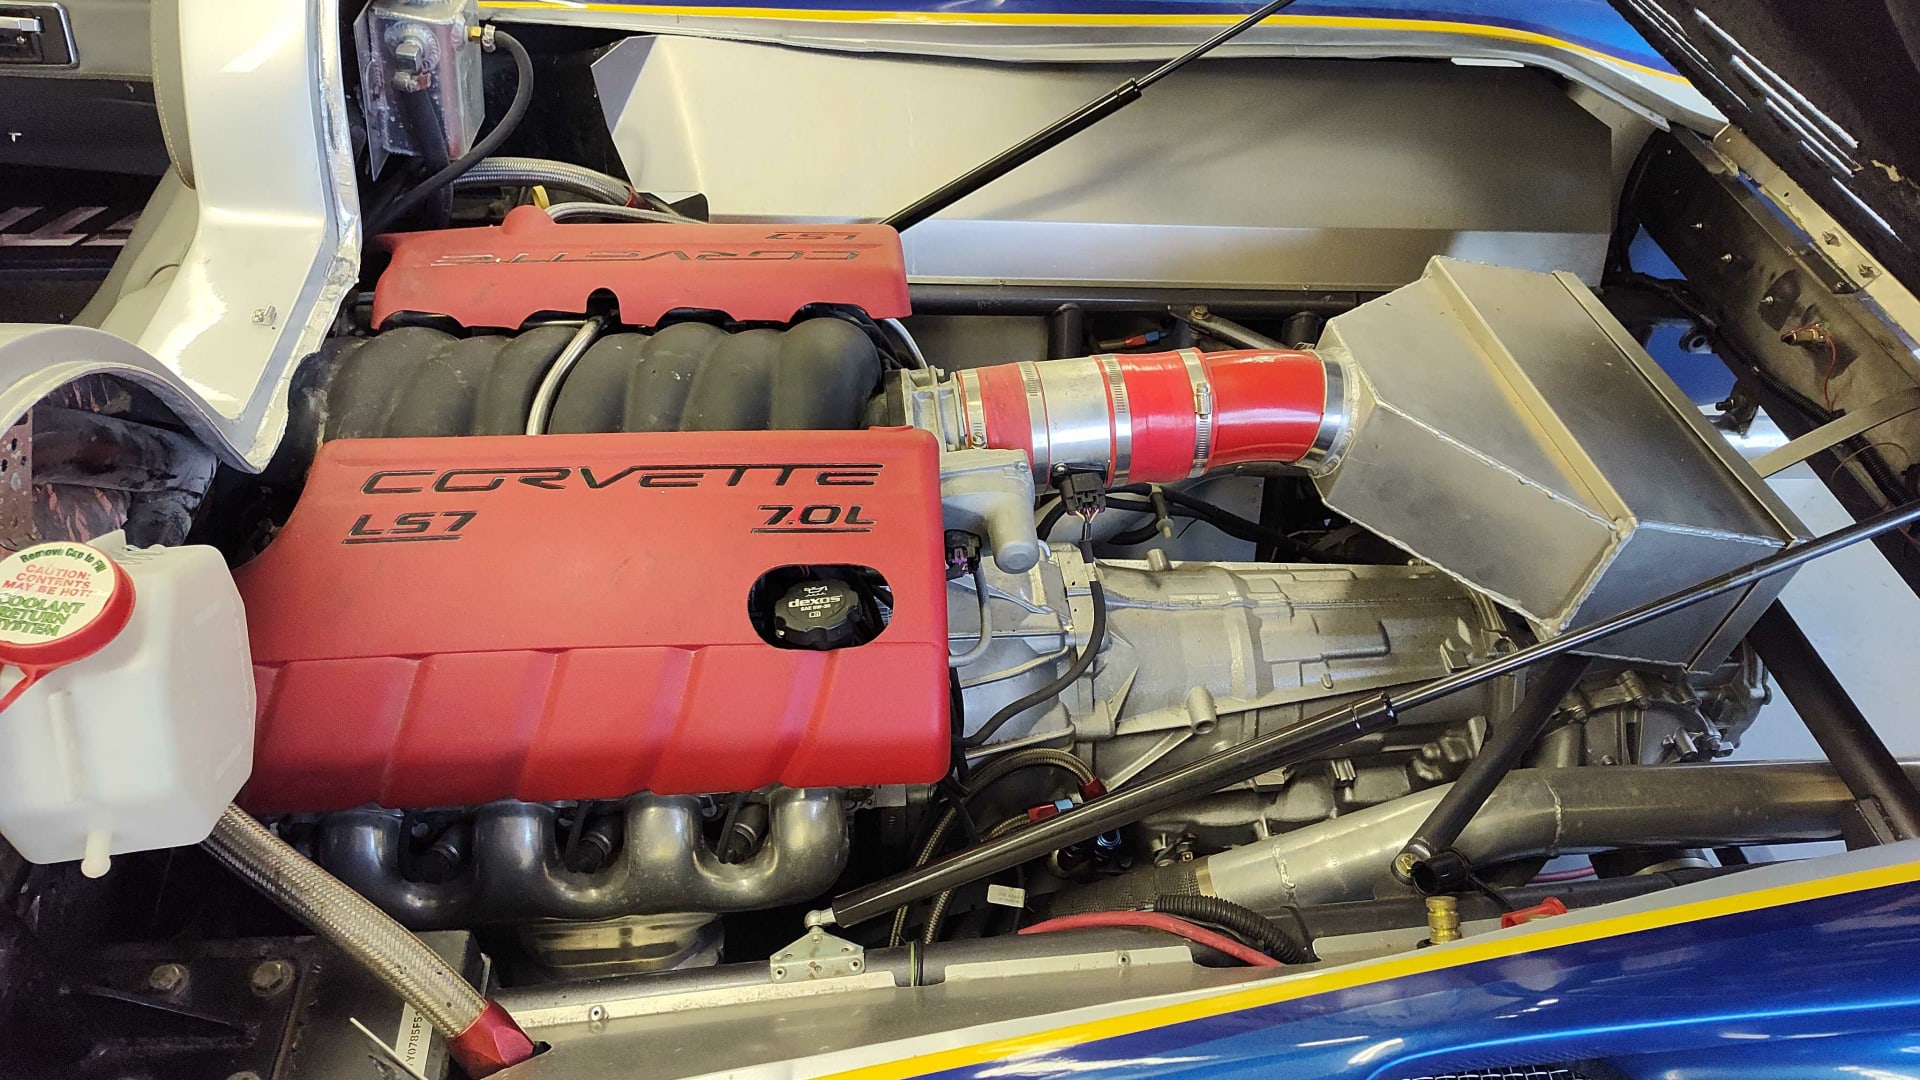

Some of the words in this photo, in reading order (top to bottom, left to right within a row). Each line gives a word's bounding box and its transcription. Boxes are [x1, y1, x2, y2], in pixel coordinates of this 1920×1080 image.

[430, 250, 860, 267] CORVETTE
[360, 462, 884, 495] CORVETTE
[348, 509, 479, 537] LS7
[757, 504, 876, 526] 7.0L
[20, 547, 64, 563] Remove
[65, 547, 84, 560] Cap
[84, 552, 95, 564] to
[16, 572, 91, 589] CONTENTS
[25, 563, 91, 581] CAUTION:
[2, 580, 33, 592] MAY
[36, 585, 57, 595] BE
[788, 595, 842, 608] dexos
[0, 617, 61, 636] YSTEM
